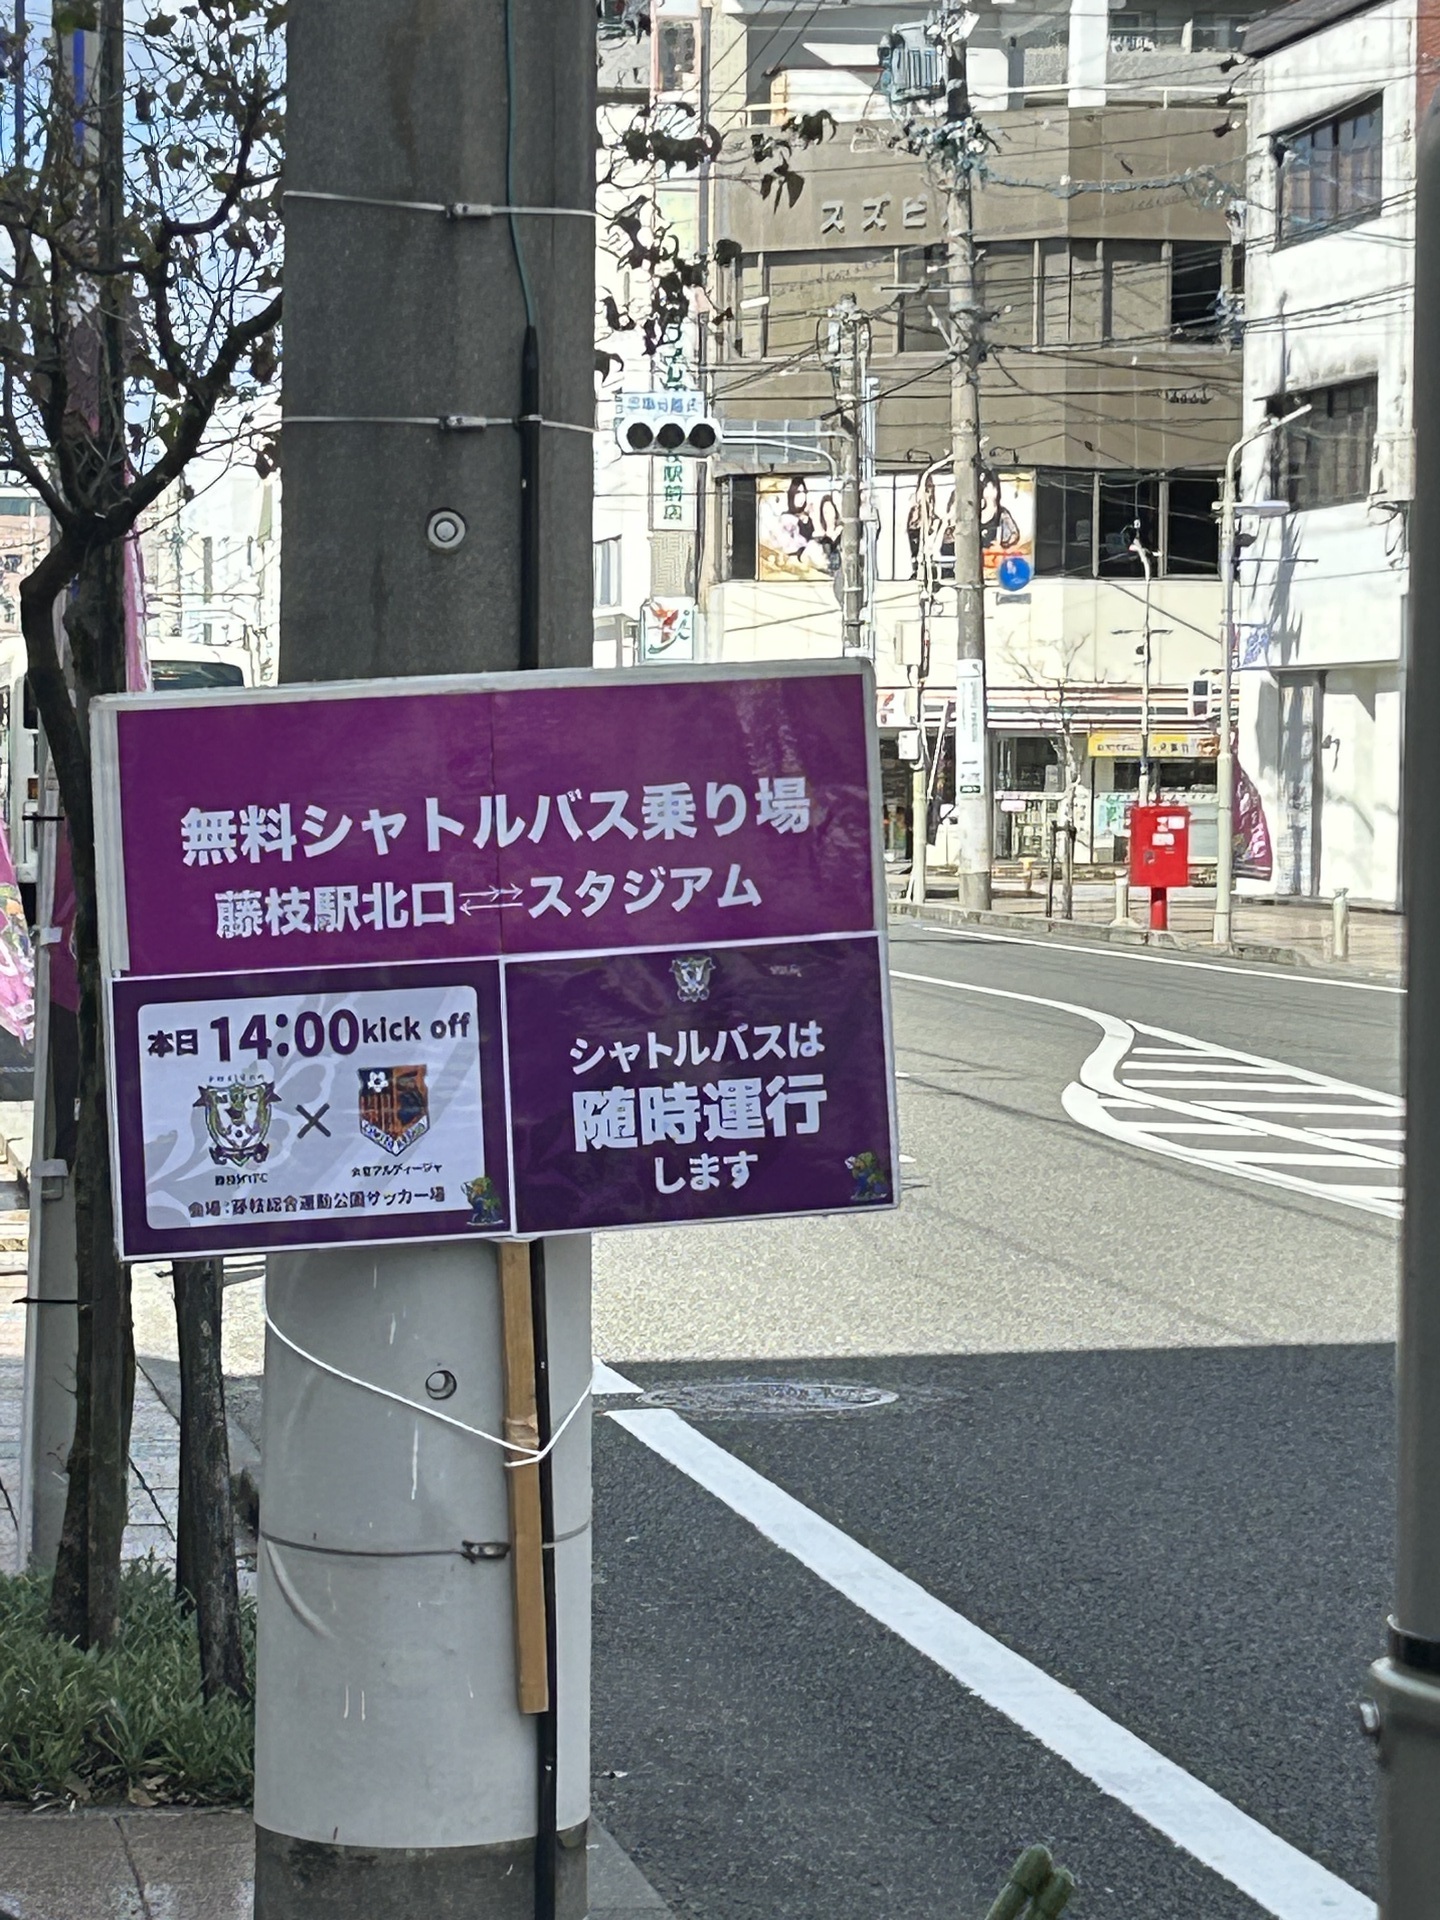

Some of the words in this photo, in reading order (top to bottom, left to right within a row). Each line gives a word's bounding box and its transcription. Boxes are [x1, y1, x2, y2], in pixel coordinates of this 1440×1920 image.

[820, 191, 949, 234] スズビ
[181, 777, 811, 865] 無料シャトルバス乗り場
[215, 881, 455, 938] 藤枝駅北口
[526, 862, 763, 922] スタジアム
[147, 1028, 200, 1058] 本日
[210, 1008, 360, 1062] 14:00
[362, 1016, 421, 1044] kick
[429, 1011, 472, 1040] off
[569, 1020, 826, 1076] シャトルバスは
[573, 1074, 827, 1152] 随時運行
[653, 1150, 760, 1195] します
